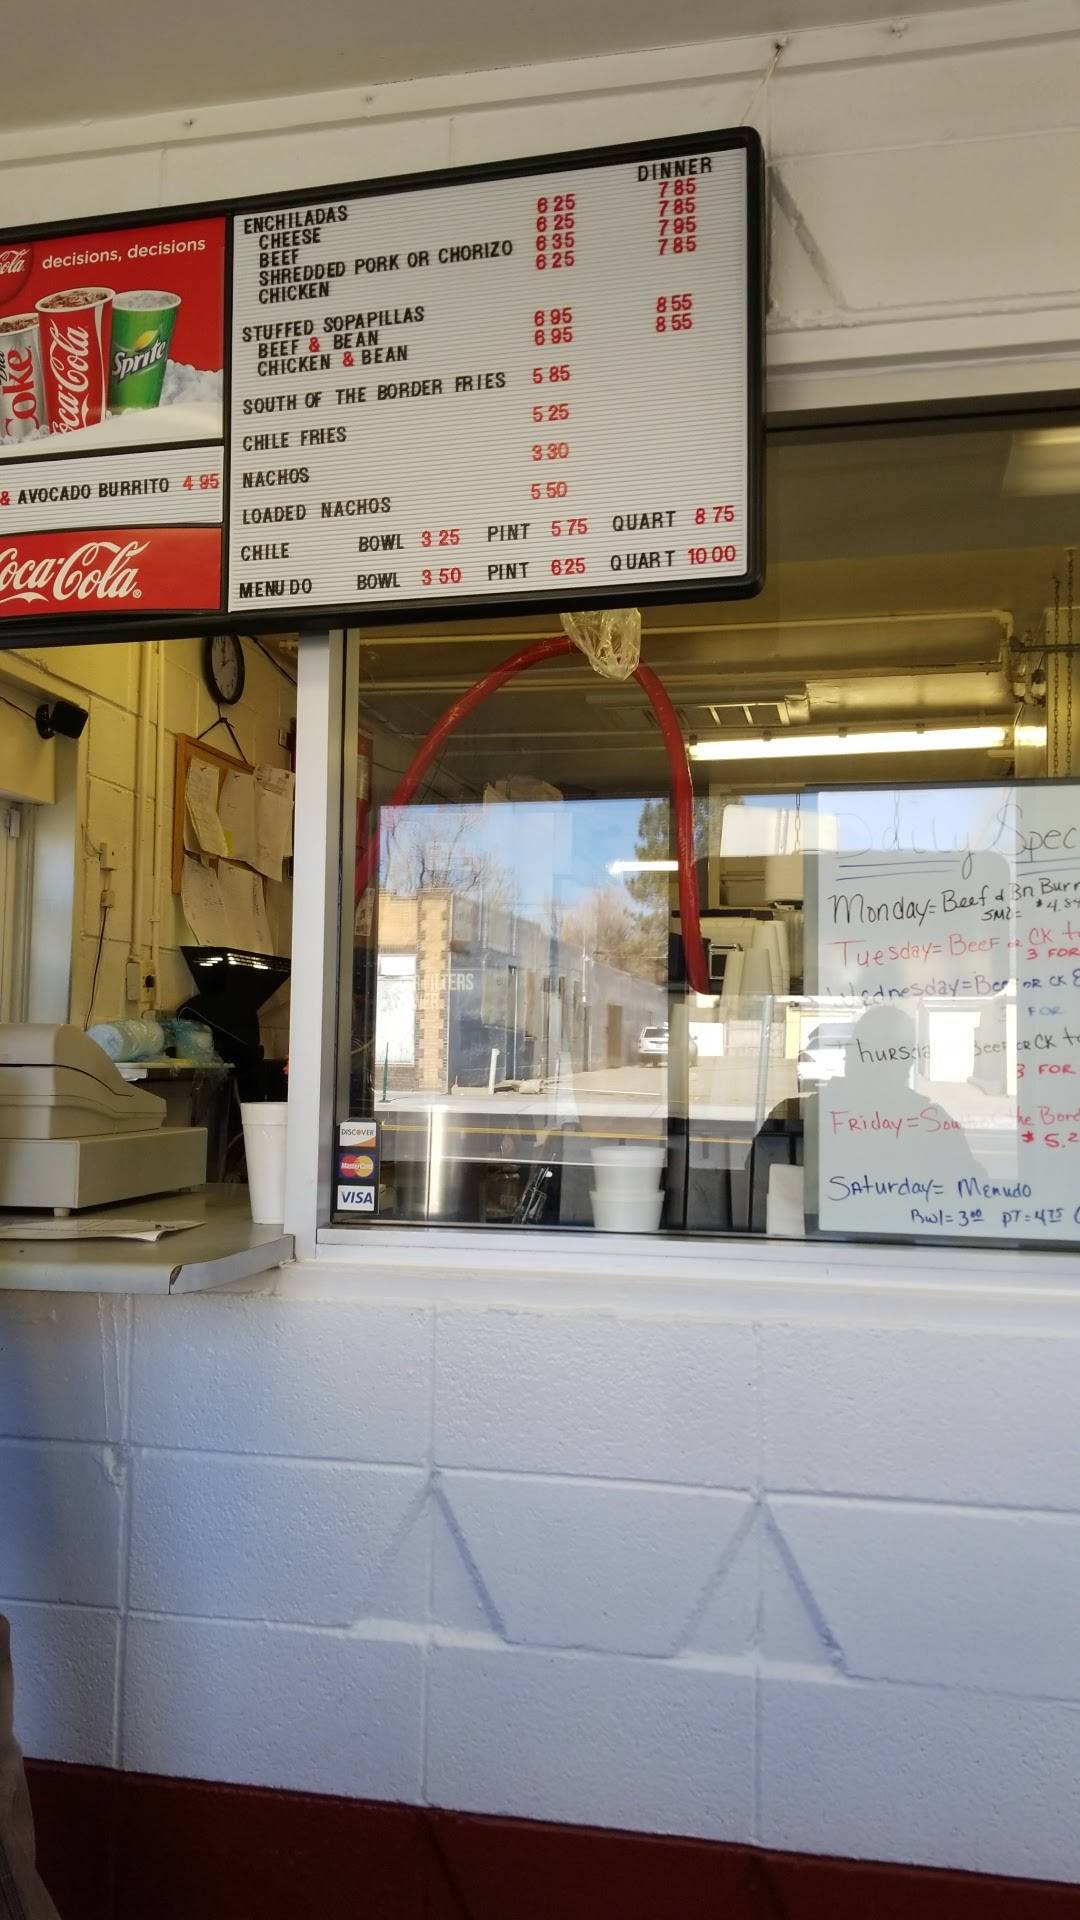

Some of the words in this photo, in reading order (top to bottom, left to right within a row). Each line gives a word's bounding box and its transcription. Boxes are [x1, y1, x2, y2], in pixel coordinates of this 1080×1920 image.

[638, 156, 712, 182] DINNER
[243, 205, 348, 234] ENCHILADAS
[259, 227, 321, 250] CHEESE
[42, 250, 122, 270] decisions,
[127, 238, 206, 259] decisions
[259, 261, 345, 287] SHREDDED
[355, 254, 399, 275] PORK
[407, 251, 429, 268] OR
[439, 240, 513, 264] CHORIZO
[260, 249, 300, 268] BEEF
[259, 281, 330, 304] CHICKEN
[243, 320, 314, 343] STUFFED
[323, 306, 425, 334] SOPAPILLAS
[259, 340, 299, 359] BEEF
[308, 336, 320, 353] &
[334, 330, 379, 351] BEAN
[112, 338, 167, 380] Sprite
[258, 356, 330, 377] CHICKEN
[342, 352, 355, 368] &
[362, 344, 408, 365] BEAN
[243, 394, 297, 415] SOUTH
[304, 391, 323, 408] OF
[336, 387, 367, 404] THE
[378, 379, 443, 401] BORDER
[455, 372, 507, 393] FRIES
[243, 432, 289, 451] CHILE
[301, 426, 347, 446] FRIES
[243, 467, 310, 488] NACHOS
[0, 490, 11, 506] &
[18, 486, 92, 505] AVOCADO
[98, 477, 170, 498] BURRITO
[243, 504, 307, 525] LOADED
[321, 497, 391, 519] NACHOS
[241, 542, 290, 562] CHILE
[358, 533, 404, 553] BOWL
[487, 523, 530, 543] PINT
[612, 510, 677, 532] QUART
[357, 571, 402, 591] BOWL
[487, 561, 529, 582] PINT
[610, 550, 676, 572] QUART
[941, 885, 989, 912] Beef
[1027, 948, 1038, 960] 3
[1028, 1006, 1064, 1017] FOR
[1034, 1033, 1056, 1049] CK
[1038, 1064, 1077, 1075] FOR
[341, 1161, 374, 1170] MasterCard
[341, 1191, 373, 1204] VISA
